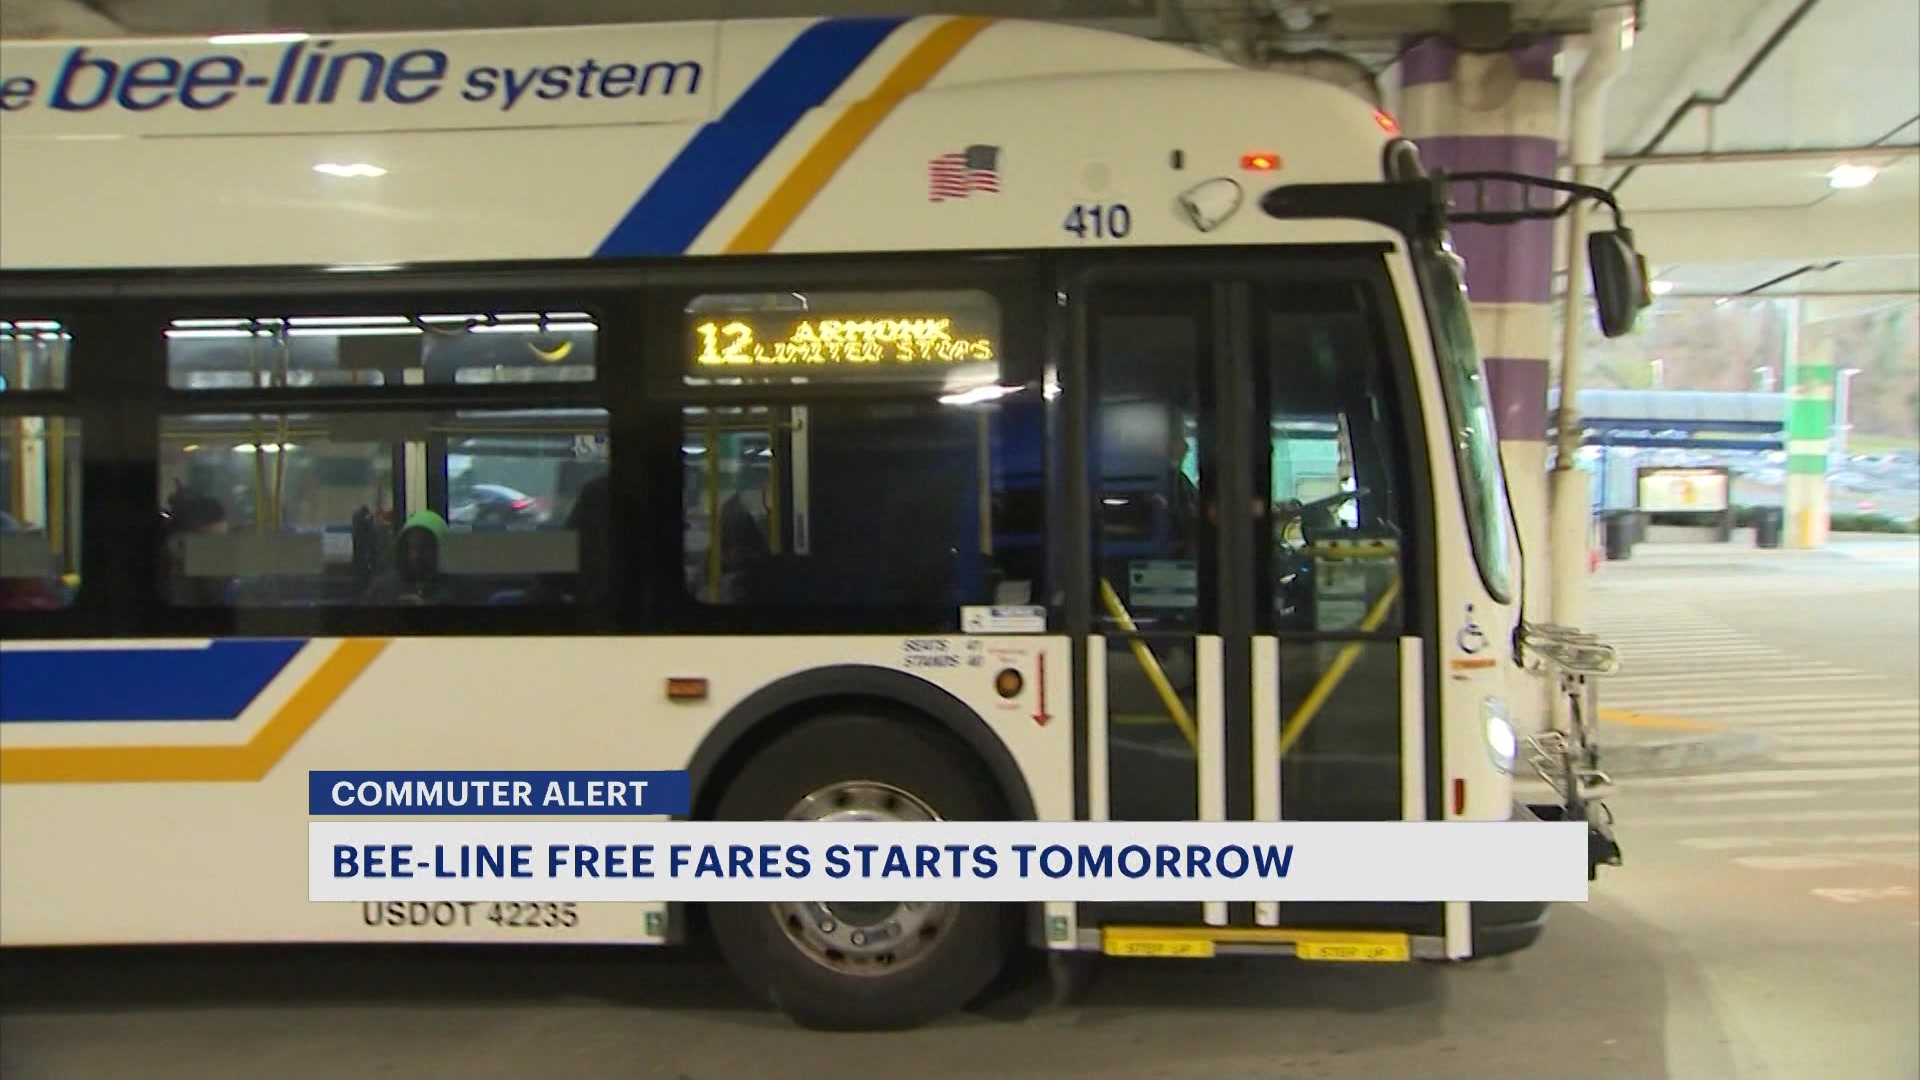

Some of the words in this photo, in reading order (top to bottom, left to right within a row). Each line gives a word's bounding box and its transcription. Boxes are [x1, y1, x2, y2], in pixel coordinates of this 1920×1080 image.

[47, 40, 448, 112] bee-line
[461, 59, 704, 111] system
[1063, 203, 1131, 239] 410
[697, 322, 754, 364] 12
[791, 318, 952, 342] ARMONK
[896, 340, 993, 361] STOPS
[362, 901, 476, 927] USDOT
[488, 901, 578, 928] 42235
